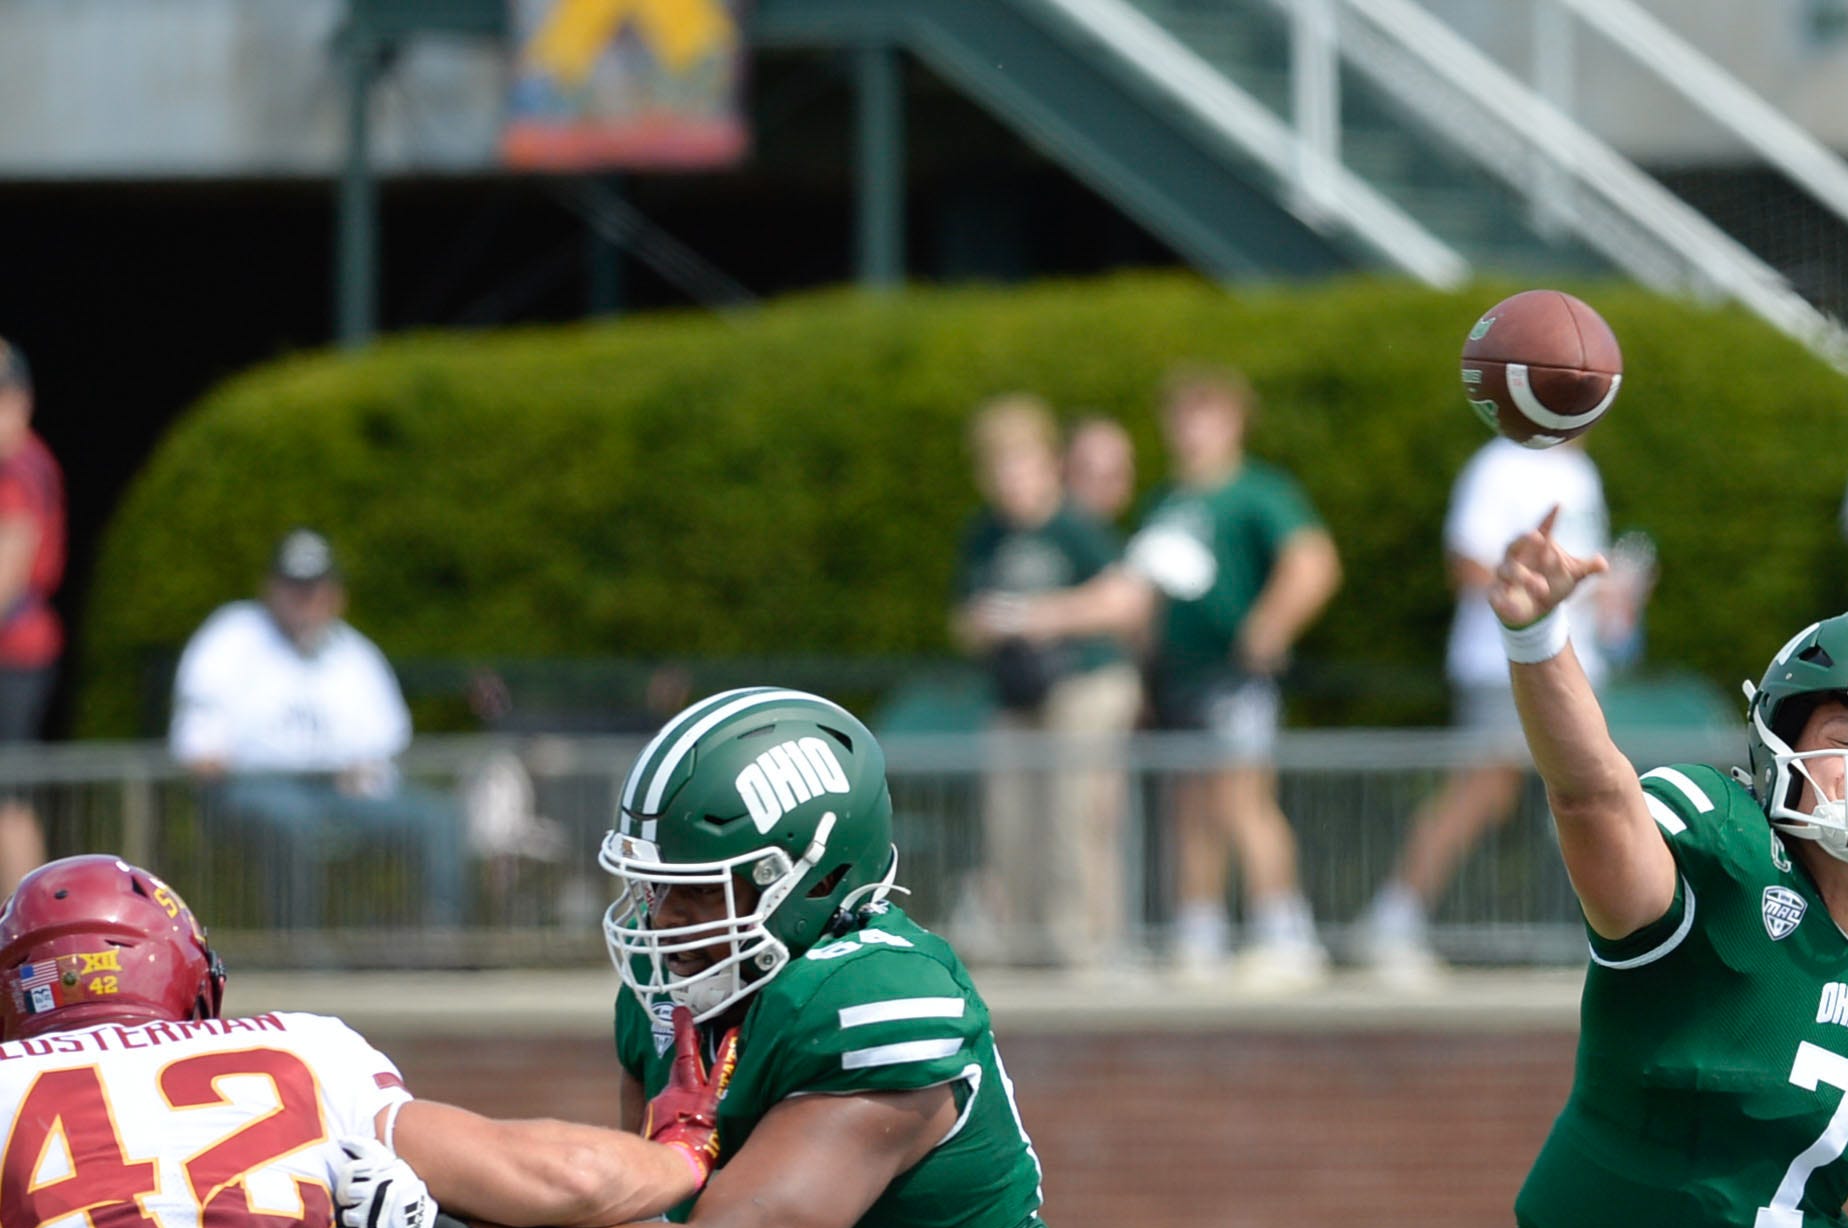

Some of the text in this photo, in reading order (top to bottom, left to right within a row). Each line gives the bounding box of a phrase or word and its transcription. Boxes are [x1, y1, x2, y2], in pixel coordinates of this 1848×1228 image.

[736, 737, 850, 835] OHIO
[78, 950, 122, 975] XII
[88, 975, 118, 995] 42
